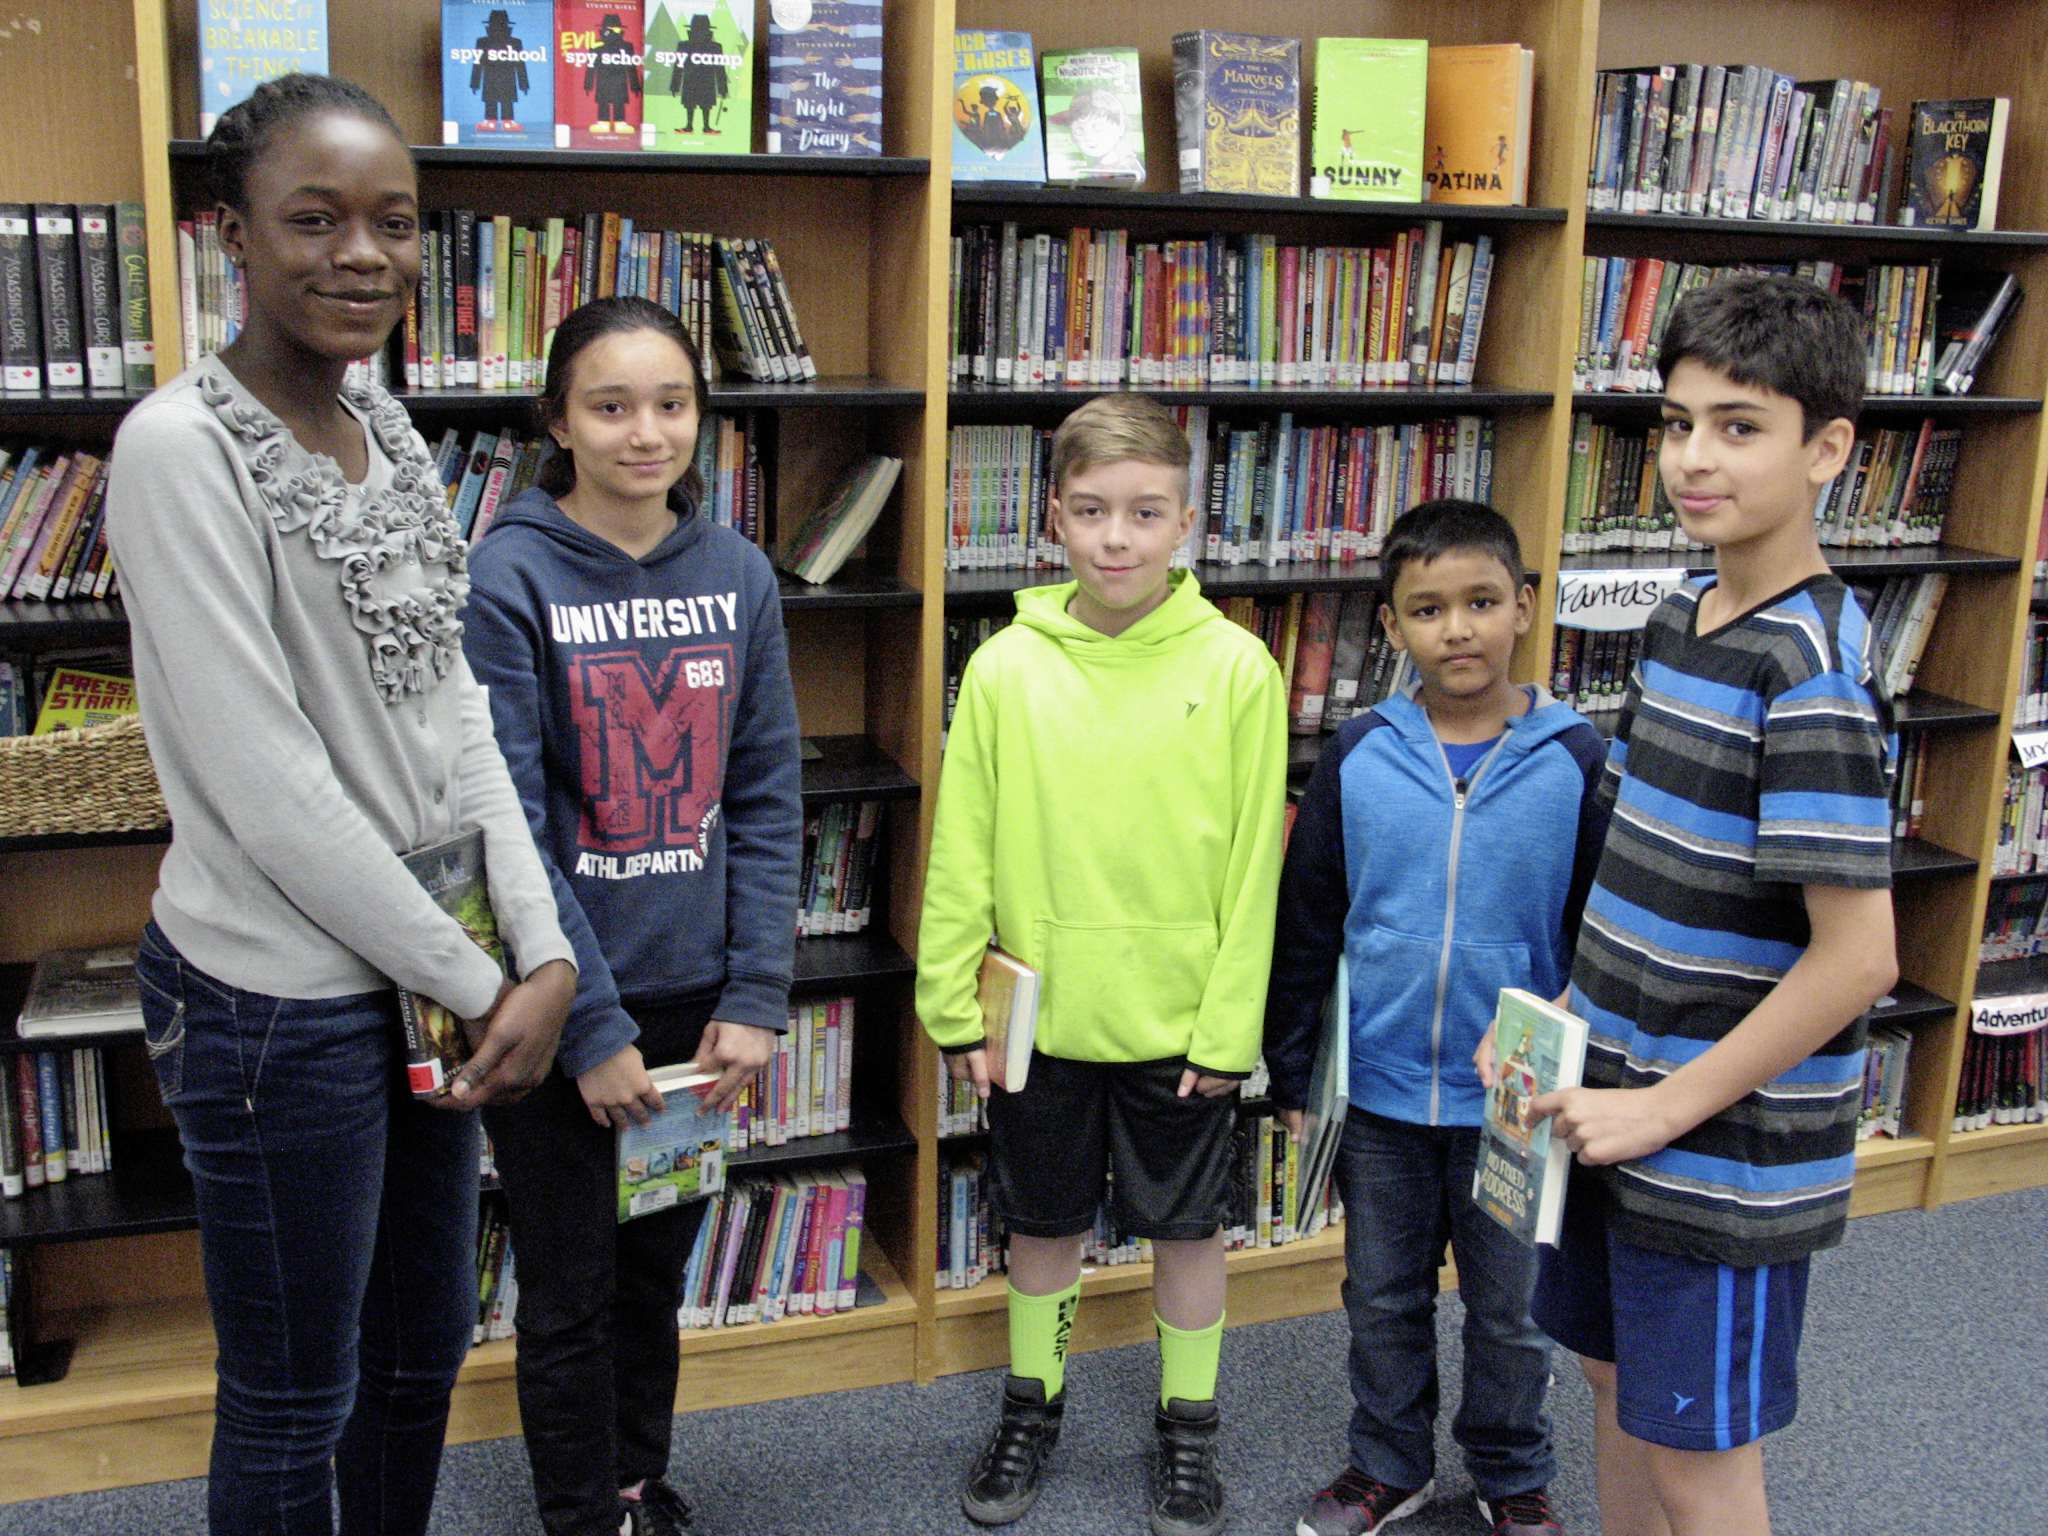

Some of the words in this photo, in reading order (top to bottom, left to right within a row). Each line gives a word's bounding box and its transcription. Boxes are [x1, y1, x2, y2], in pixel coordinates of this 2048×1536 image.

[206, 27, 320, 51] BREAKABLE
[560, 31, 605, 50] EVIL
[451, 47, 483, 64] spy
[487, 45, 548, 63] school
[566, 52, 598, 67] spy
[601, 49, 643, 65] scho
[655, 51, 688, 68] spy
[691, 52, 743, 69] camp
[812, 72, 840, 90] The
[1222, 69, 1284, 90] MARVELS
[796, 98, 846, 118] Night
[1922, 116, 1989, 135] BLACKTHORN
[799, 128, 851, 153] Diary
[1945, 134, 1968, 152] KEY
[1324, 166, 1402, 187] SUNNY
[1428, 172, 1504, 191] PATINA
[457, 285, 476, 336] REFUGEE
[1210, 464, 1225, 515] HOUDINI
[551, 593, 737, 643] UNIVERSITY
[57, 672, 131, 696] PRESS
[685, 660, 725, 689] 683
[48, 692, 134, 711] START!
[1977, 1007, 2048, 1027] Adventu
[1499, 1158, 1525, 1189] FIXED
[1479, 1167, 1526, 1218] ADDRESS
